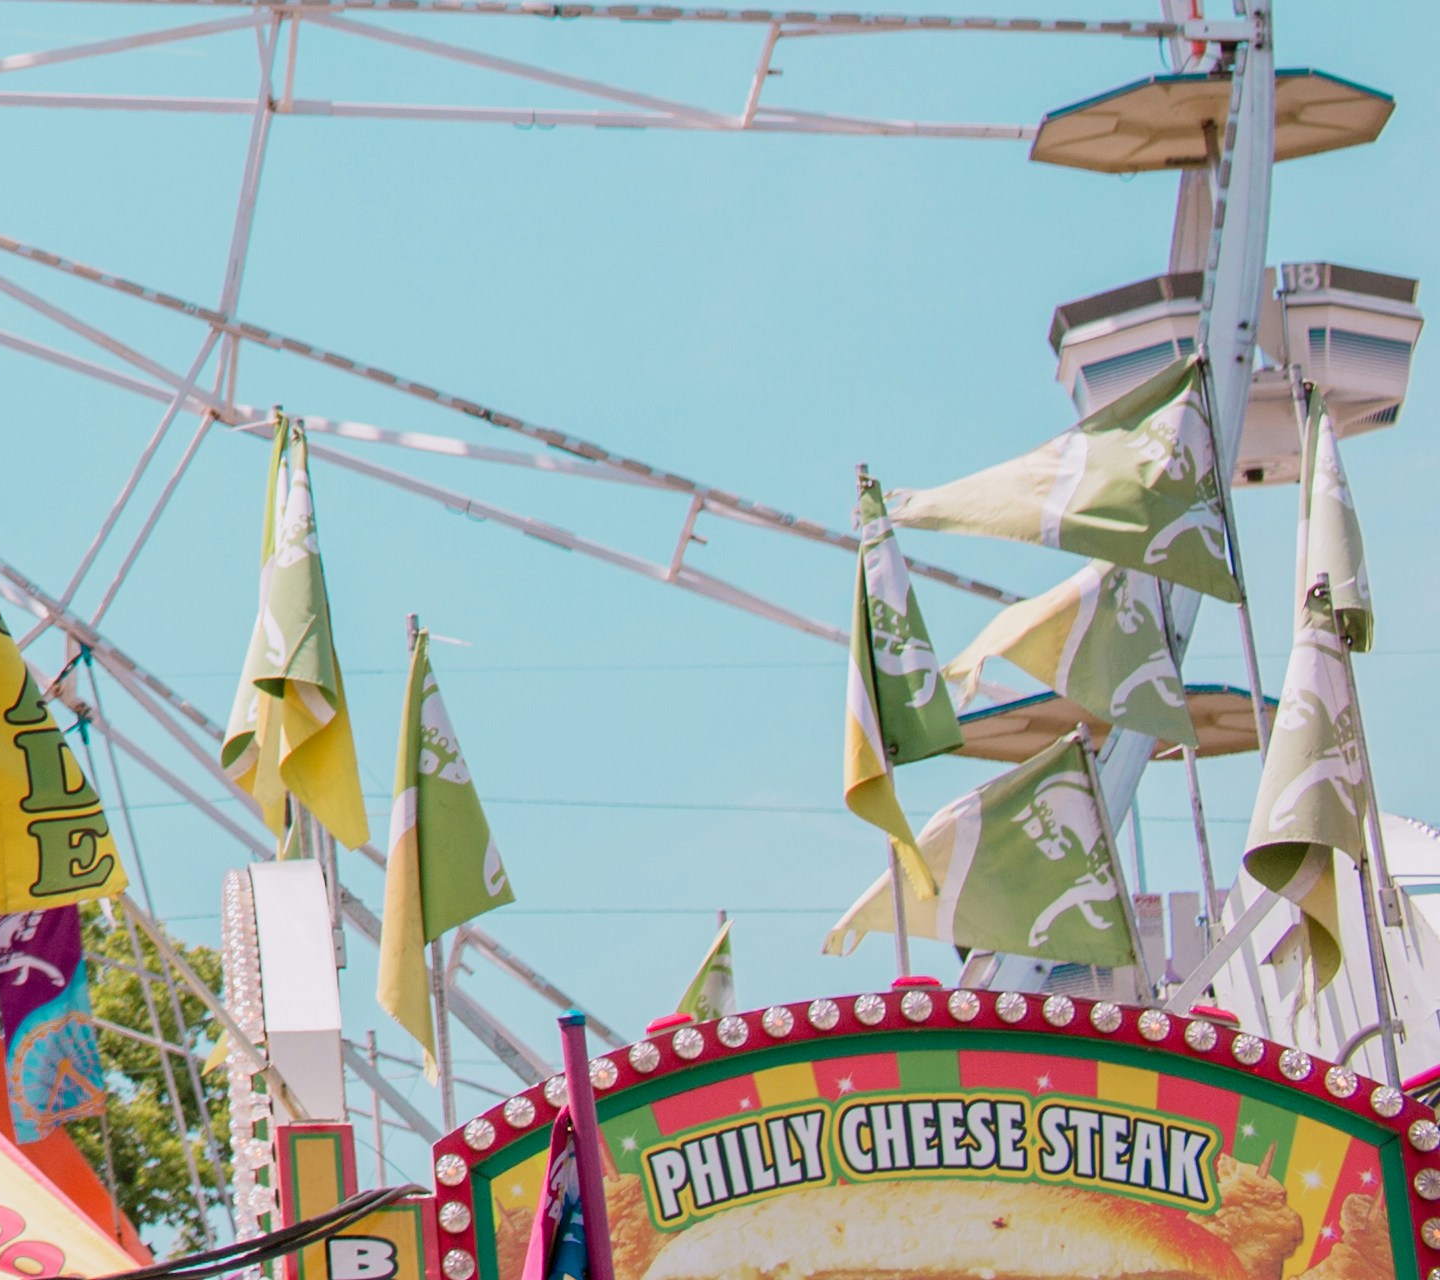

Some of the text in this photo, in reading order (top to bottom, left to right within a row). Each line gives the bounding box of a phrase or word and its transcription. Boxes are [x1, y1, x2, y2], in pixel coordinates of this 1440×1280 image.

[1283, 263, 1321, 291] 18
[648, 1099, 1215, 1220] PHILLY CHEESE STEAK
